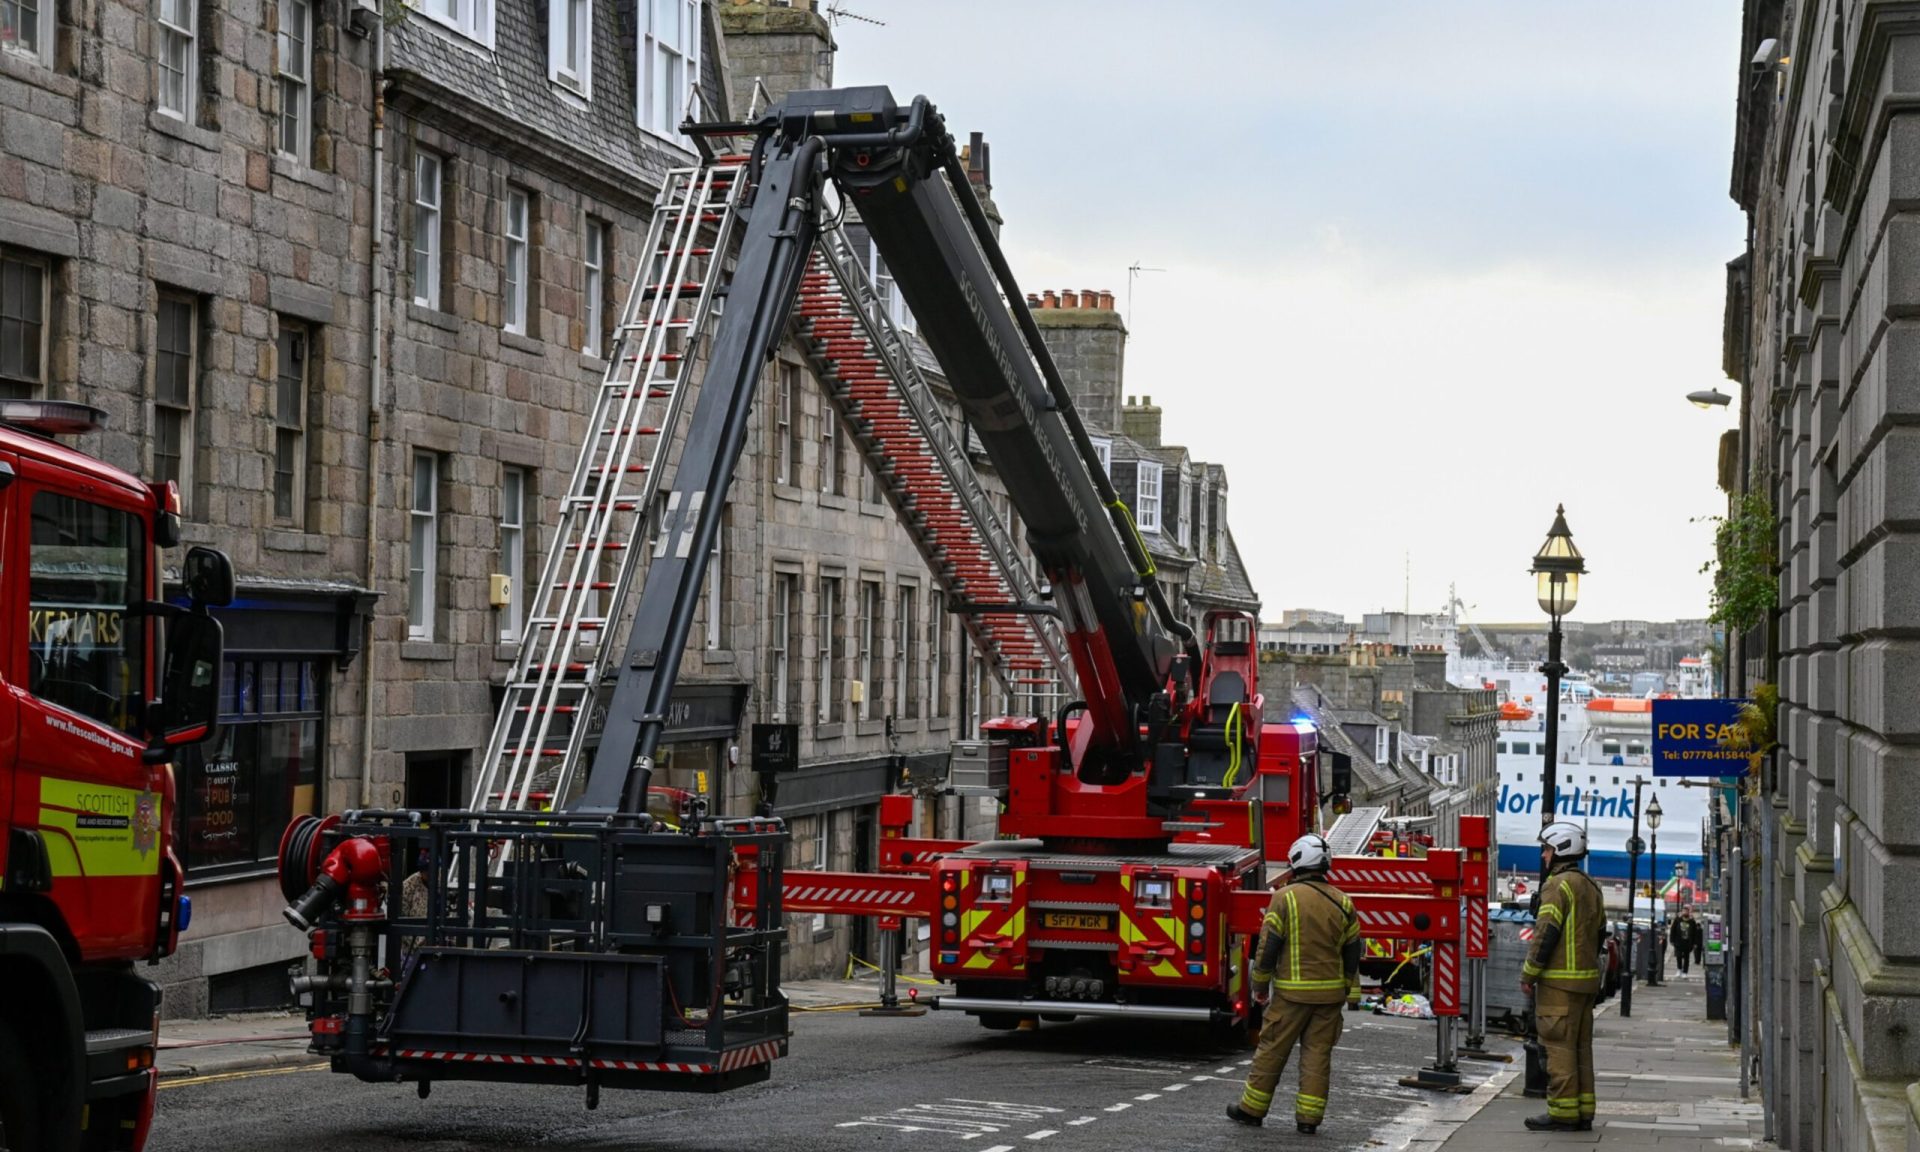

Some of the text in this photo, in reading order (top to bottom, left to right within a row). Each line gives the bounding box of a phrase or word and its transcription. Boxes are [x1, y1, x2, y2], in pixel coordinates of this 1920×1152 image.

[959, 269, 1089, 535] SCOTTISH FIRE AND RESCUE SERVICE
[45, 715, 135, 758] www.firescotland.gov.uk
[1658, 723, 1700, 740] FOR
[1663, 750, 1681, 760] Tel:
[205, 762, 239, 773] CLASSIC
[77, 794, 129, 813] SCOTTISH
[211, 789, 230, 804] PUB
[1496, 784, 1634, 819] NorhLink
[207, 810, 234, 826] FOOD
